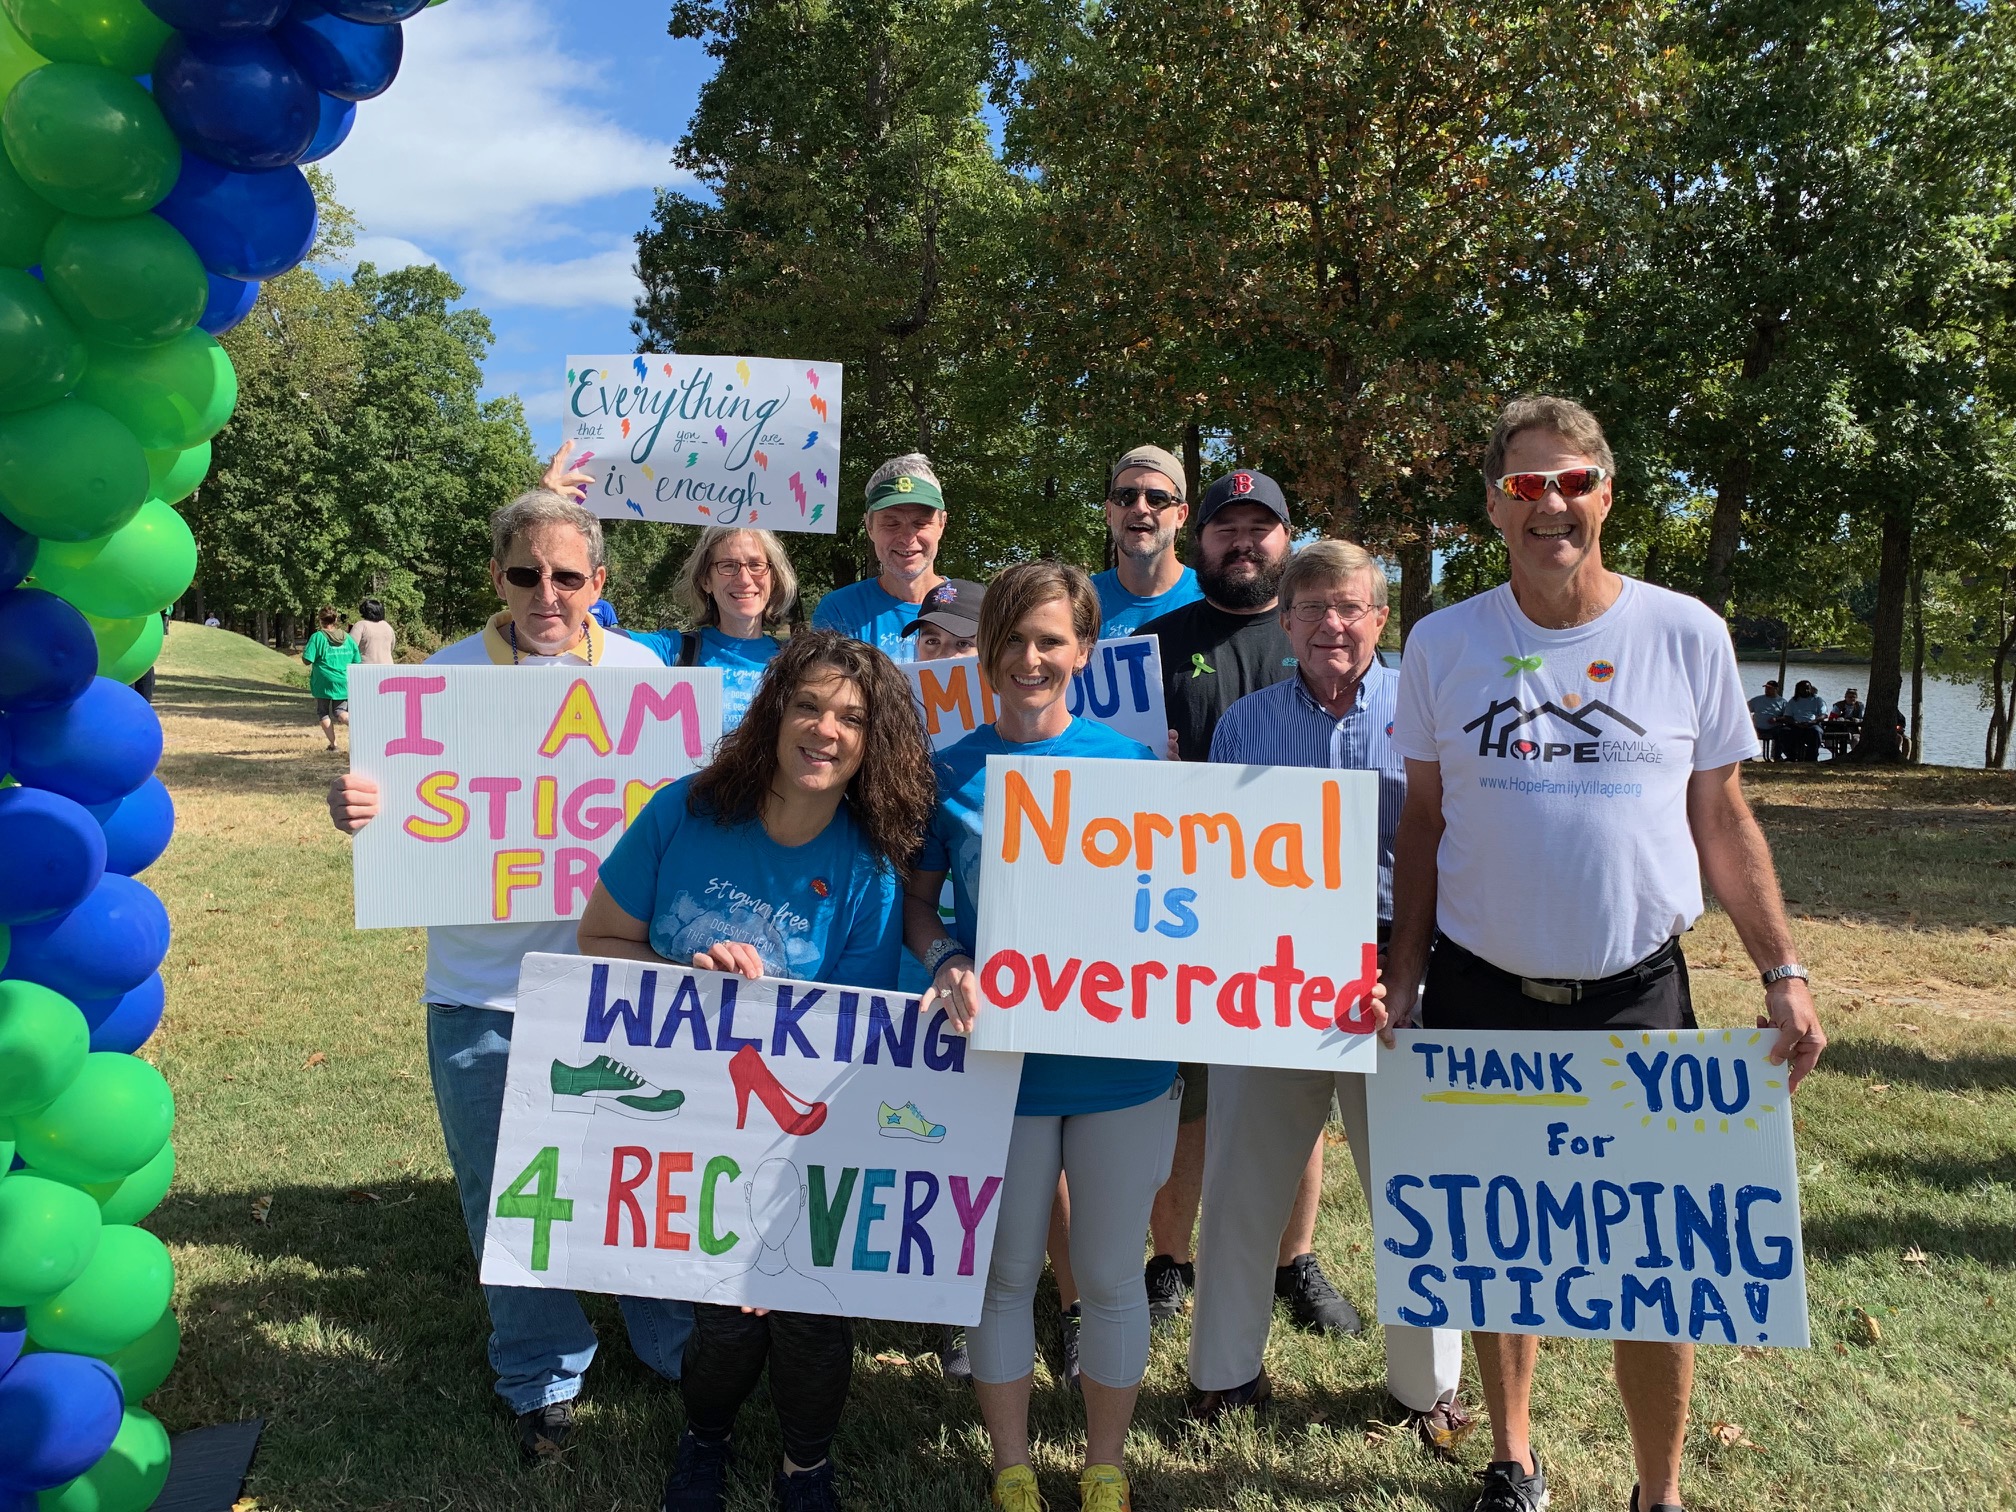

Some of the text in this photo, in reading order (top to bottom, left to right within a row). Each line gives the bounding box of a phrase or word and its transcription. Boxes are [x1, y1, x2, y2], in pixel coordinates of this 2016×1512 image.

[570, 367, 790, 471] Everything
[576, 422, 783, 452] that you are
[604, 465, 771, 524] is enough
[1232, 473, 1254, 495] B
[379, 676, 702, 759] I AM
[1602, 740, 1657, 752] FAMILY
[1479, 776, 1642, 798] www.HopeFamilyVillage.org
[1602, 751, 1664, 764] VILLAGE
[1002, 769, 1342, 890] Normal
[492, 846, 602, 921] FR
[704, 877, 810, 931] stigma free
[1133, 874, 1199, 939] is
[686, 929, 705, 944] THE
[710, 918, 750, 941] DOESN'T
[749, 935, 775, 954] MEAN
[980, 935, 1378, 1035] overrated
[583, 964, 968, 1073] WALKING
[1412, 1042, 1750, 1115] THANK YOU
[1546, 1121, 1616, 1158] For
[495, 1146, 573, 1271] 4
[1383, 1173, 1794, 1280] STOMPING
[1397, 1263, 1770, 1344] STIGMA!
